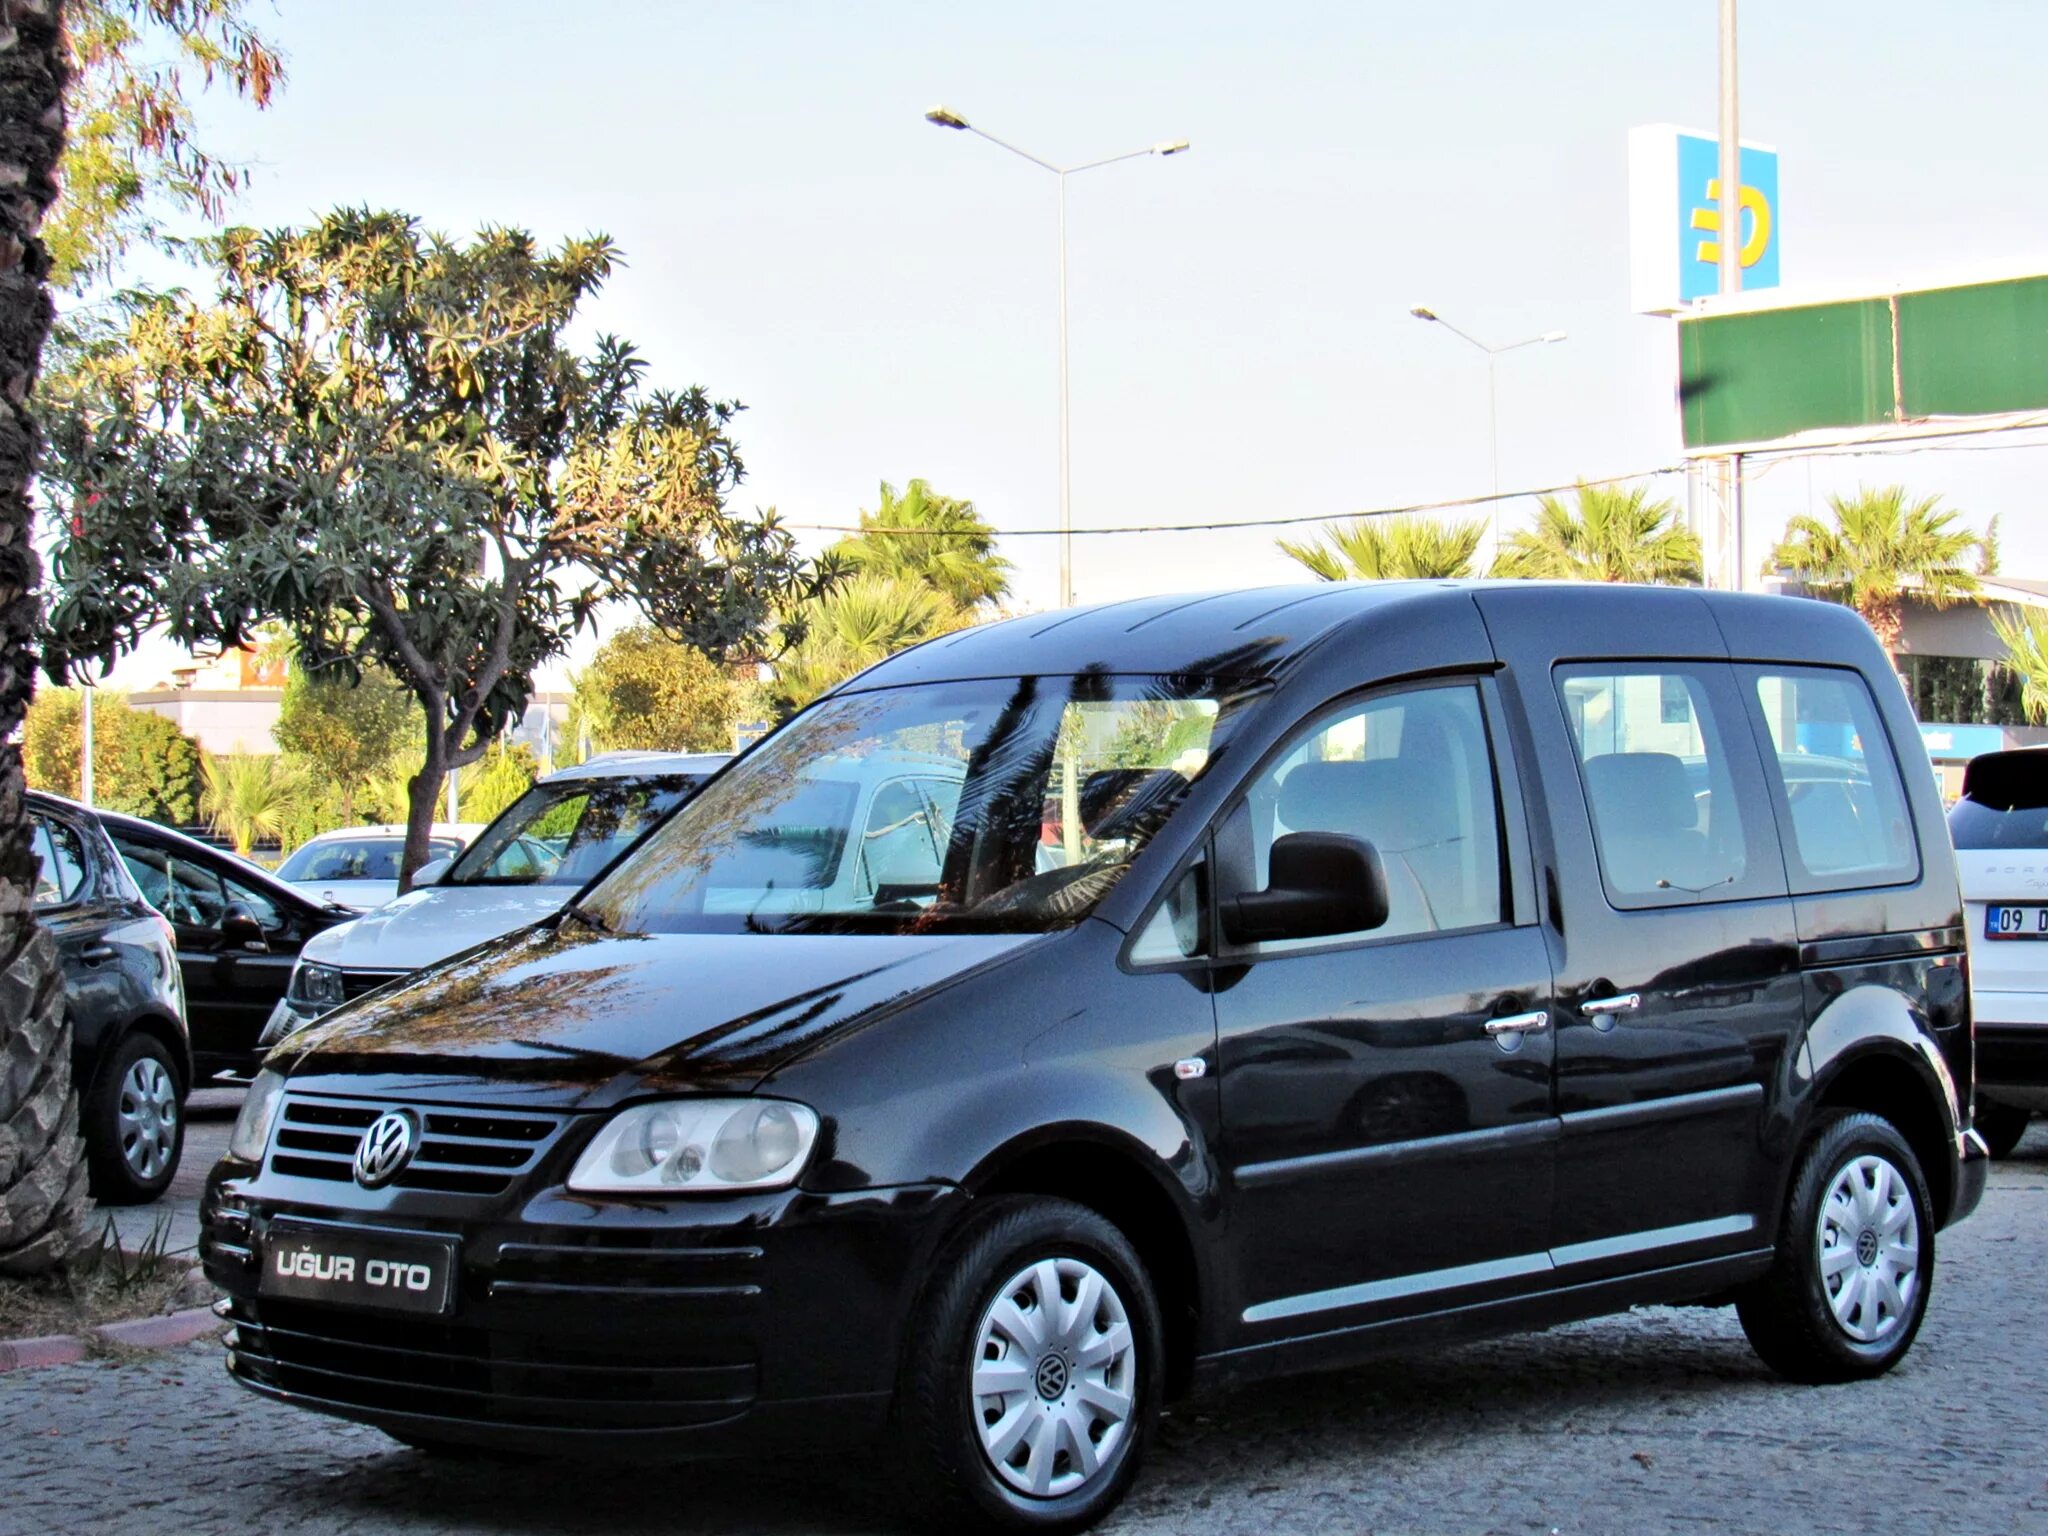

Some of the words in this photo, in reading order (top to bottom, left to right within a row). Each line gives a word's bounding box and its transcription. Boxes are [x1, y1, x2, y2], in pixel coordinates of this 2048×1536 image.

[2001, 909, 2023, 931] 09
[277, 1245, 355, 1282] UĞUR
[365, 1259, 431, 1291] OTO
